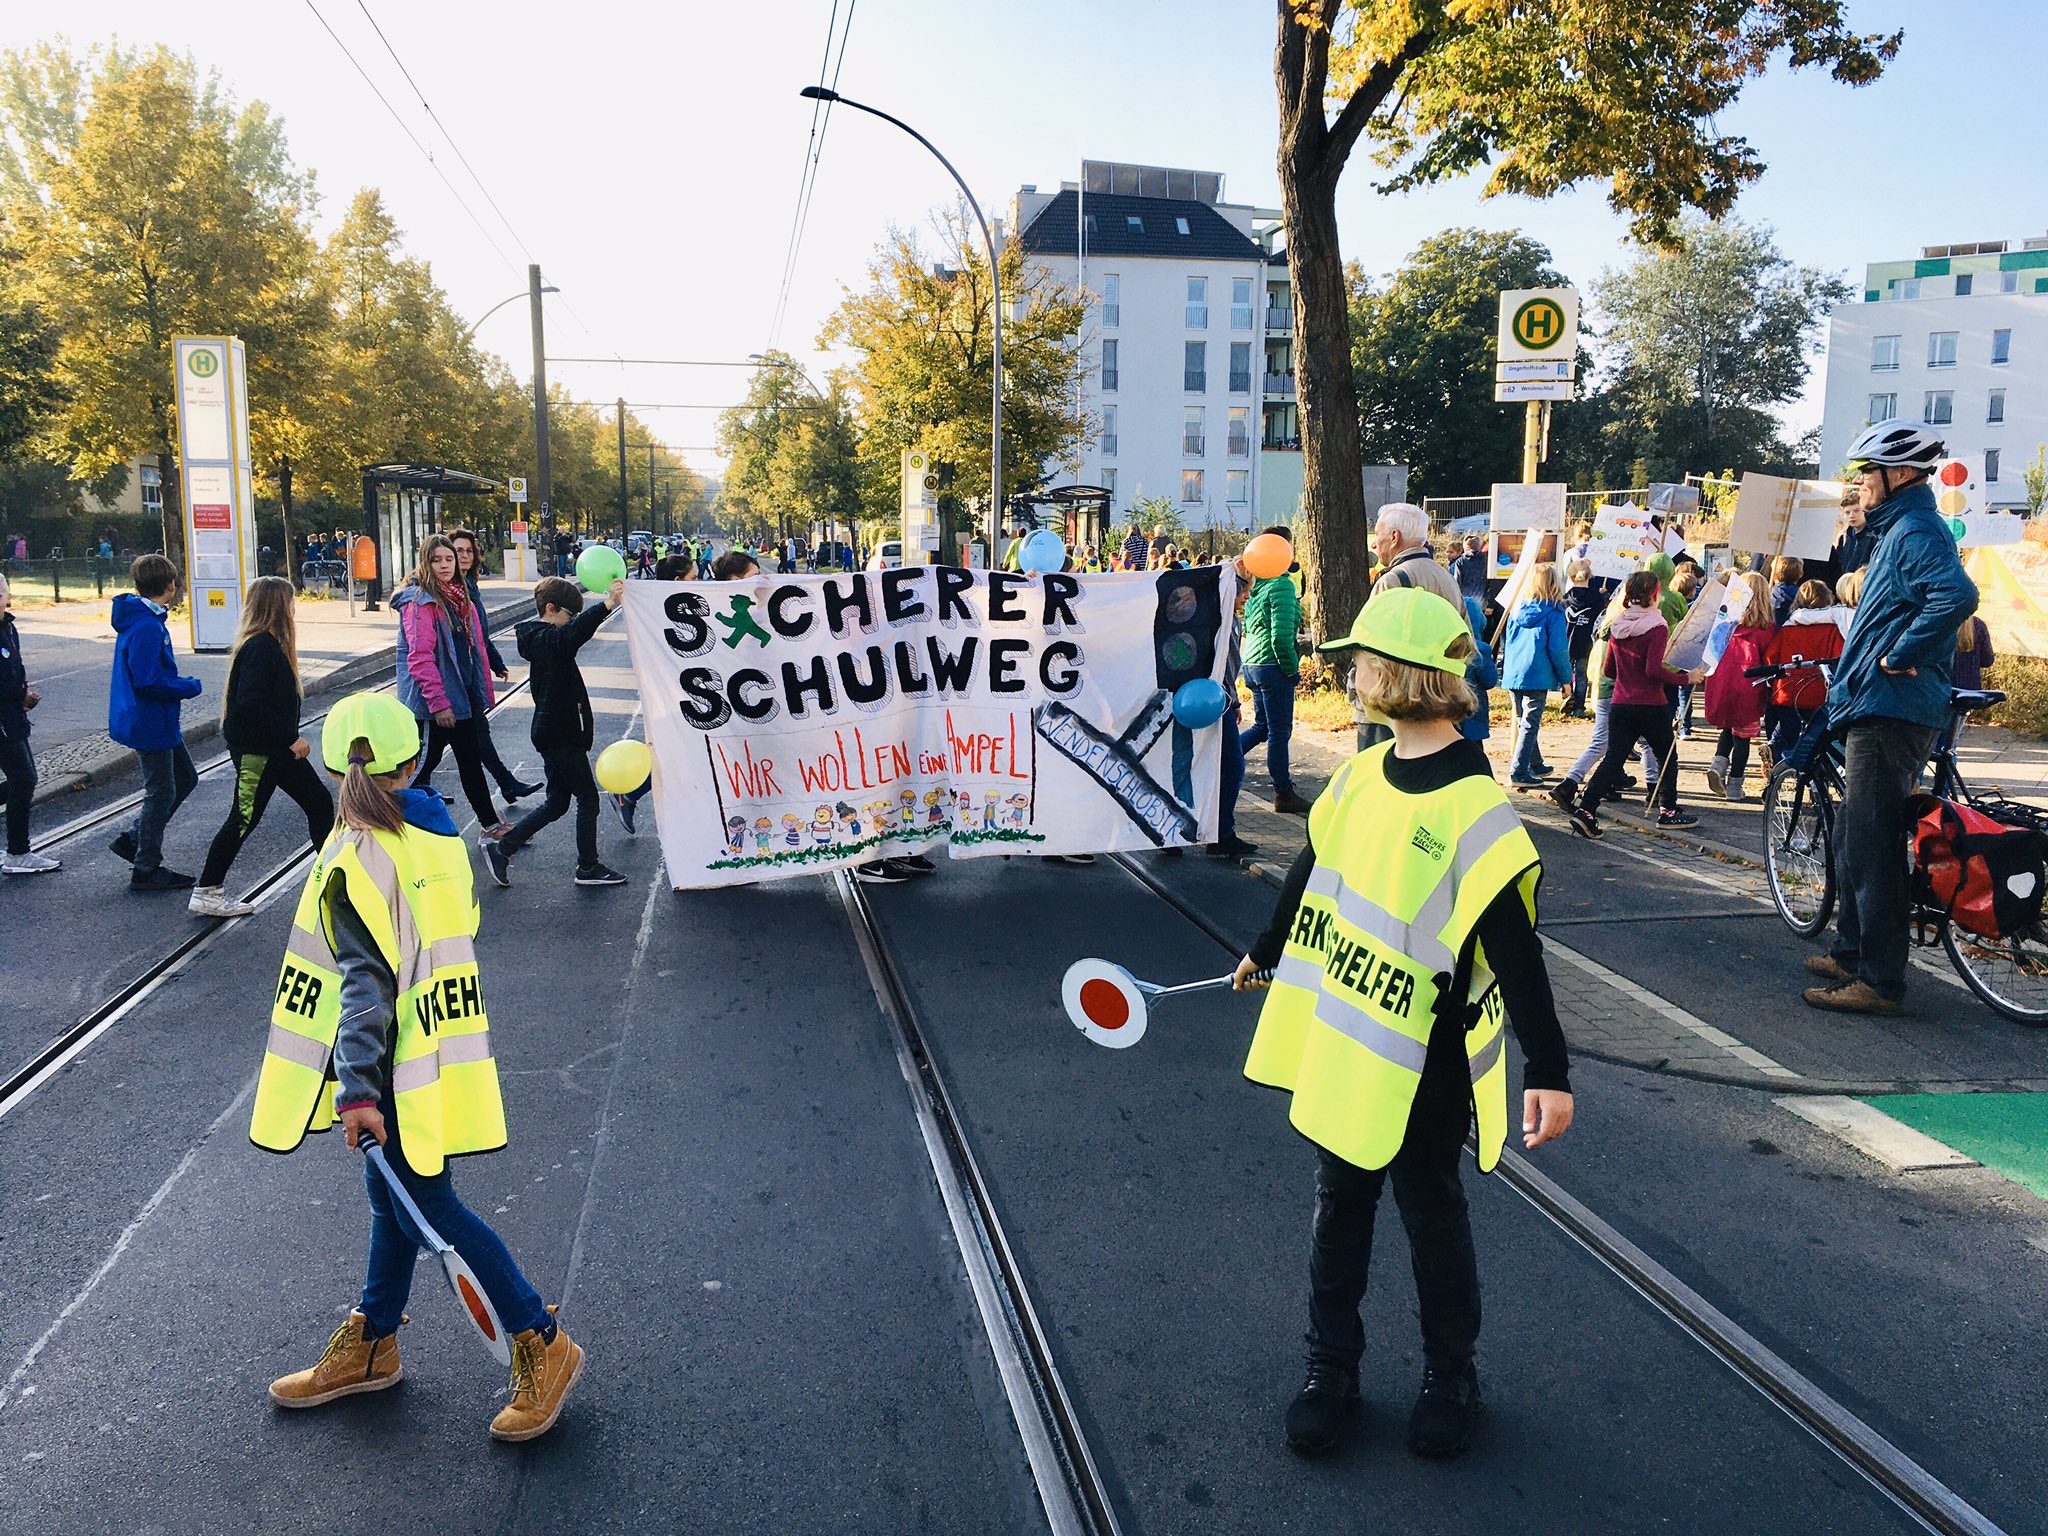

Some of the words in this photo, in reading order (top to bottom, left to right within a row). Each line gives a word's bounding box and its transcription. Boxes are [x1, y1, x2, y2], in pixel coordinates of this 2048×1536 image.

[1526, 310, 1551, 338] H
[196, 355, 210, 371] H
[210, 598, 224, 606] BVG
[679, 635, 1085, 730] SCHULWEG
[717, 739, 783, 798] WIR
[799, 726, 912, 793] WOLLEN
[946, 708, 1029, 778] AMPEL
[1413, 835, 1434, 852] WACHT
[1415, 828, 1447, 852] VERKEHRS
[276, 965, 323, 1019] FER
